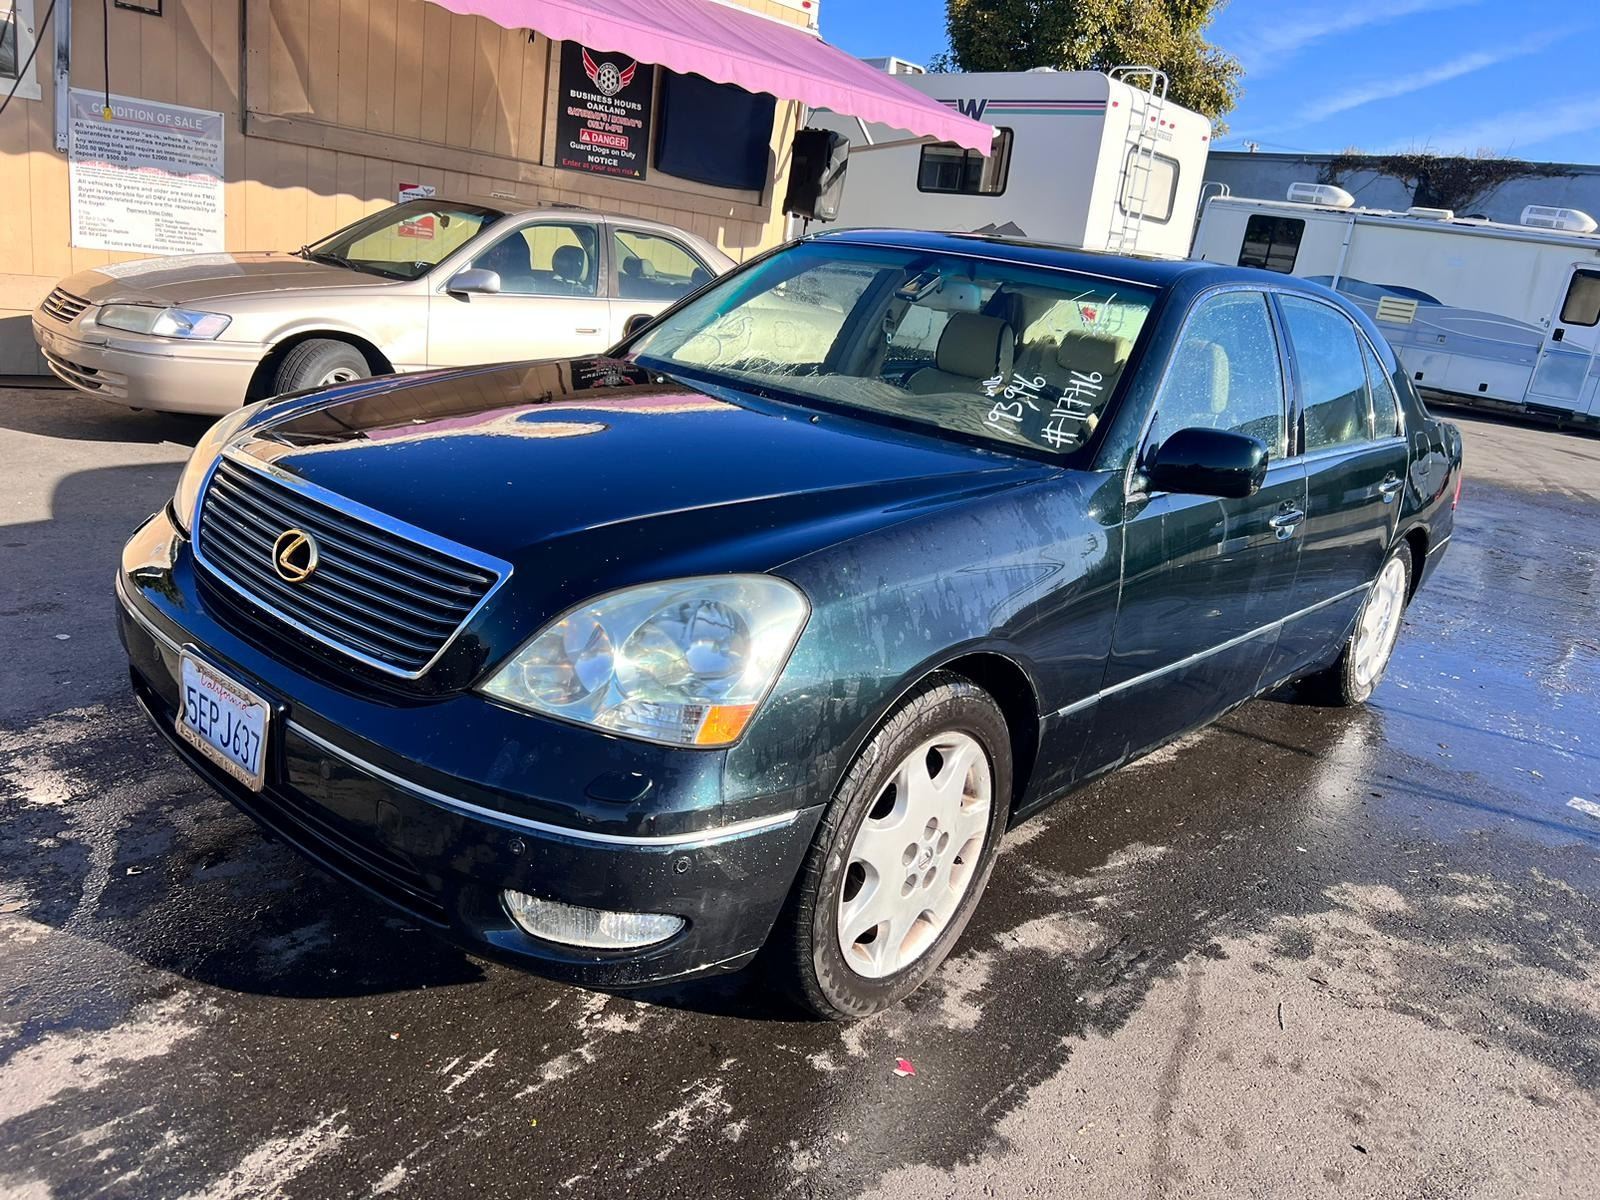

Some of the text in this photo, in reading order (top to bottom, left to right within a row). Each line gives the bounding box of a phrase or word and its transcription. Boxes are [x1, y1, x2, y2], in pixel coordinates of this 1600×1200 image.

[570, 89, 642, 111] BUSINESS HOURS
[586, 102, 626, 116] OAKLAND
[86, 124, 112, 132] vehicles
[157, 113, 171, 124] OF
[174, 115, 203, 130] SALE
[88, 139, 110, 147] winning
[121, 136, 153, 145] warranties
[591, 133, 626, 147] DANGER
[75, 150, 97, 158] deposit
[98, 146, 121, 155] Winning
[570, 141, 591, 151] Guard
[592, 144, 610, 155] Dogs
[620, 150, 636, 160] Duty
[562, 158, 581, 167] Enter
[591, 163, 607, 171] your
[587, 154, 619, 167] NOTICE
[186, 685, 260, 773] 5EPJ637
